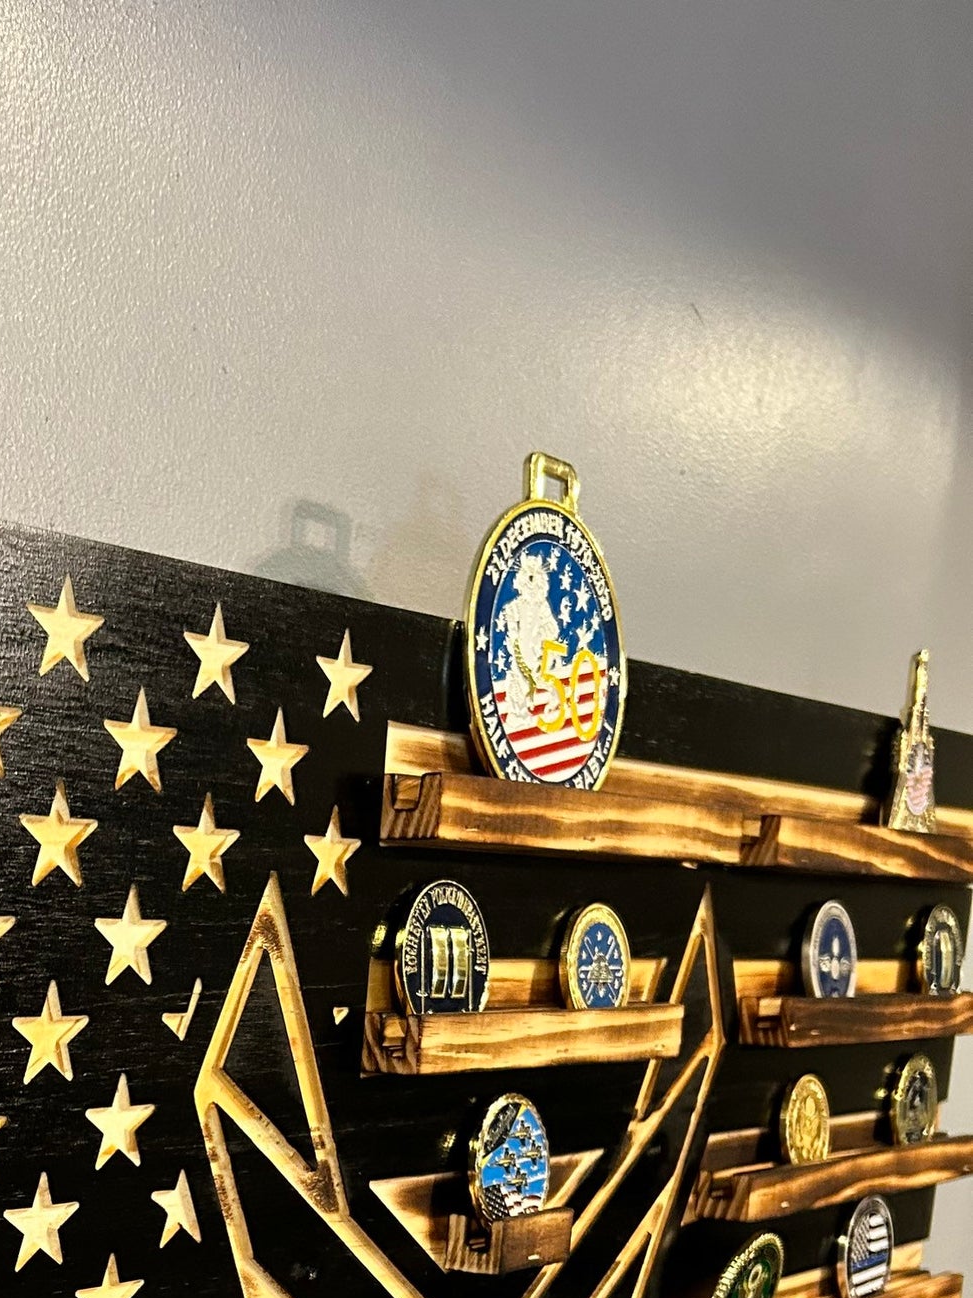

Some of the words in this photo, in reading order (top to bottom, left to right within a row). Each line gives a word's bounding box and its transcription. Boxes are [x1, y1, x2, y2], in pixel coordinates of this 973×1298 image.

[498, 511, 563, 559] DECEMBER
[537, 640, 600, 742] 50
[480, 692, 510, 758] HALF
